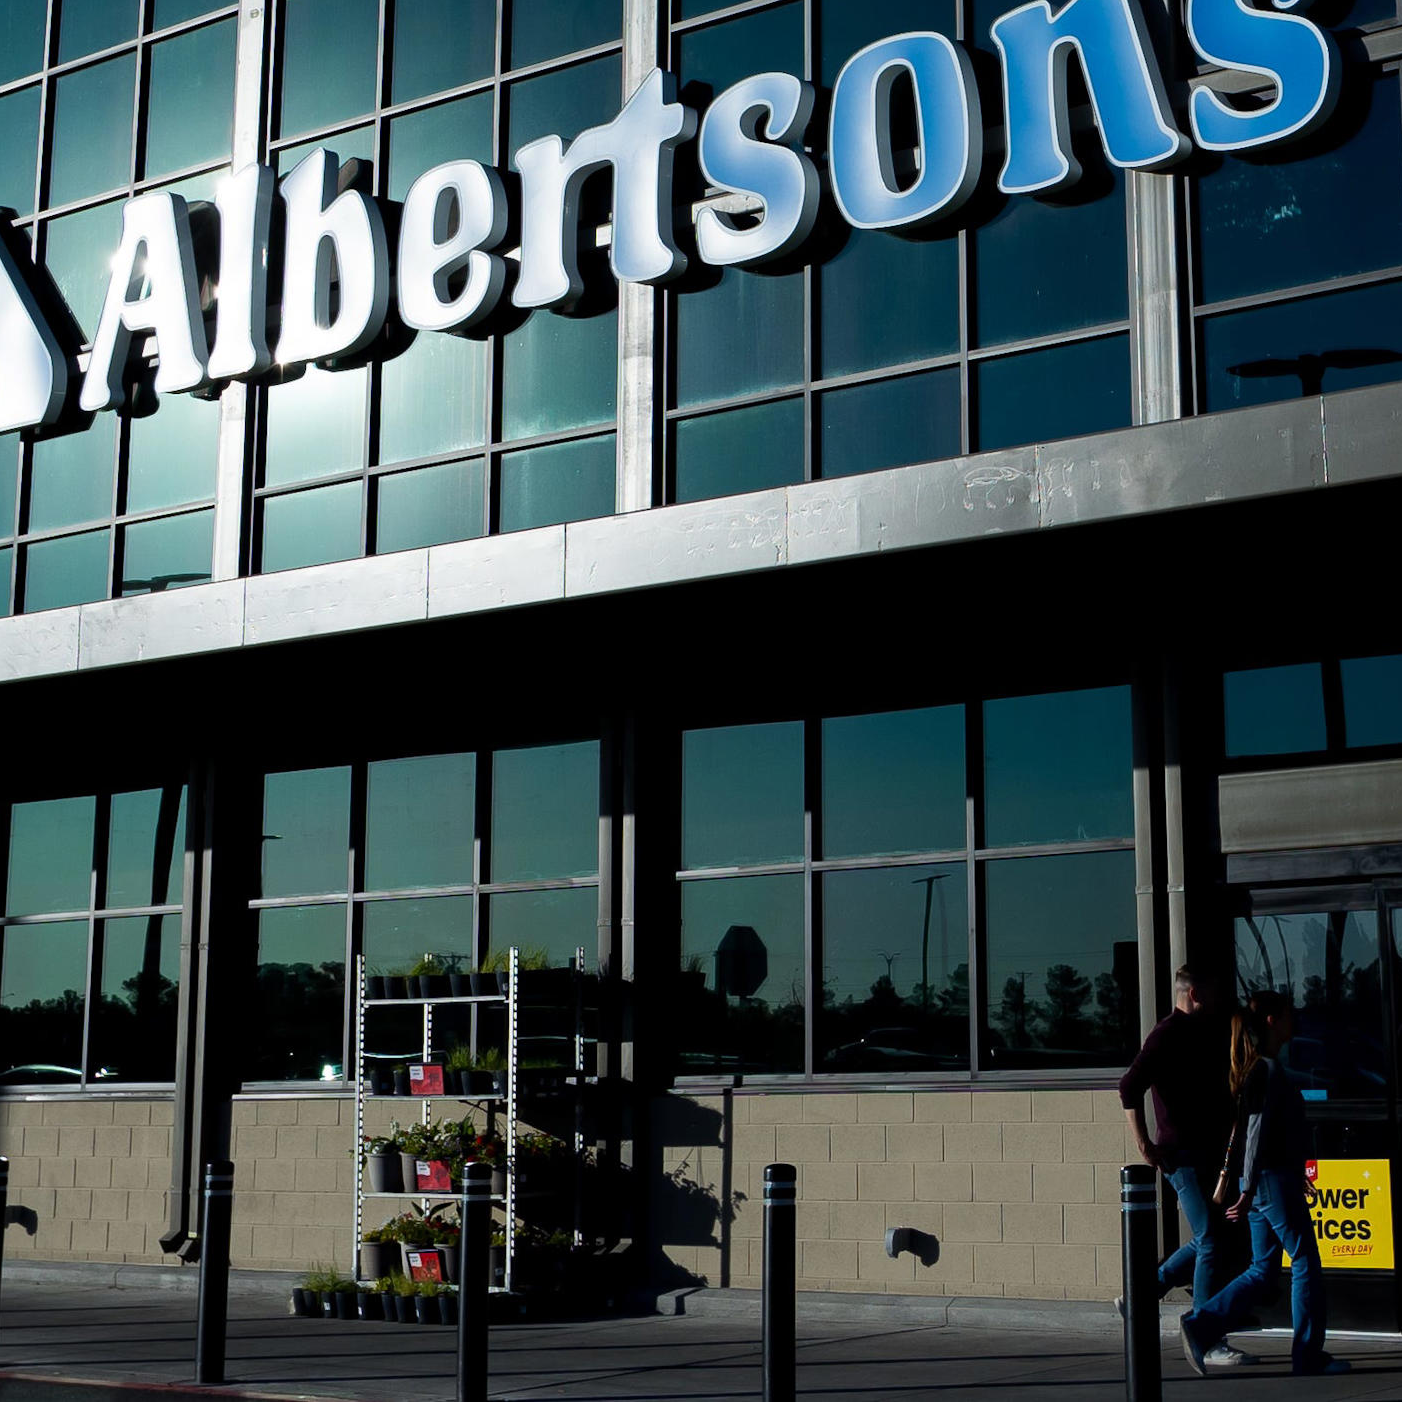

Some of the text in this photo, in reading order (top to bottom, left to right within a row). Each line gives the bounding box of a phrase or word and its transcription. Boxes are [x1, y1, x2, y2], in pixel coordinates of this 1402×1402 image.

[1305, 1188, 1370, 1210] ower
[1332, 1244, 1374, 1255] EVERY DAY
